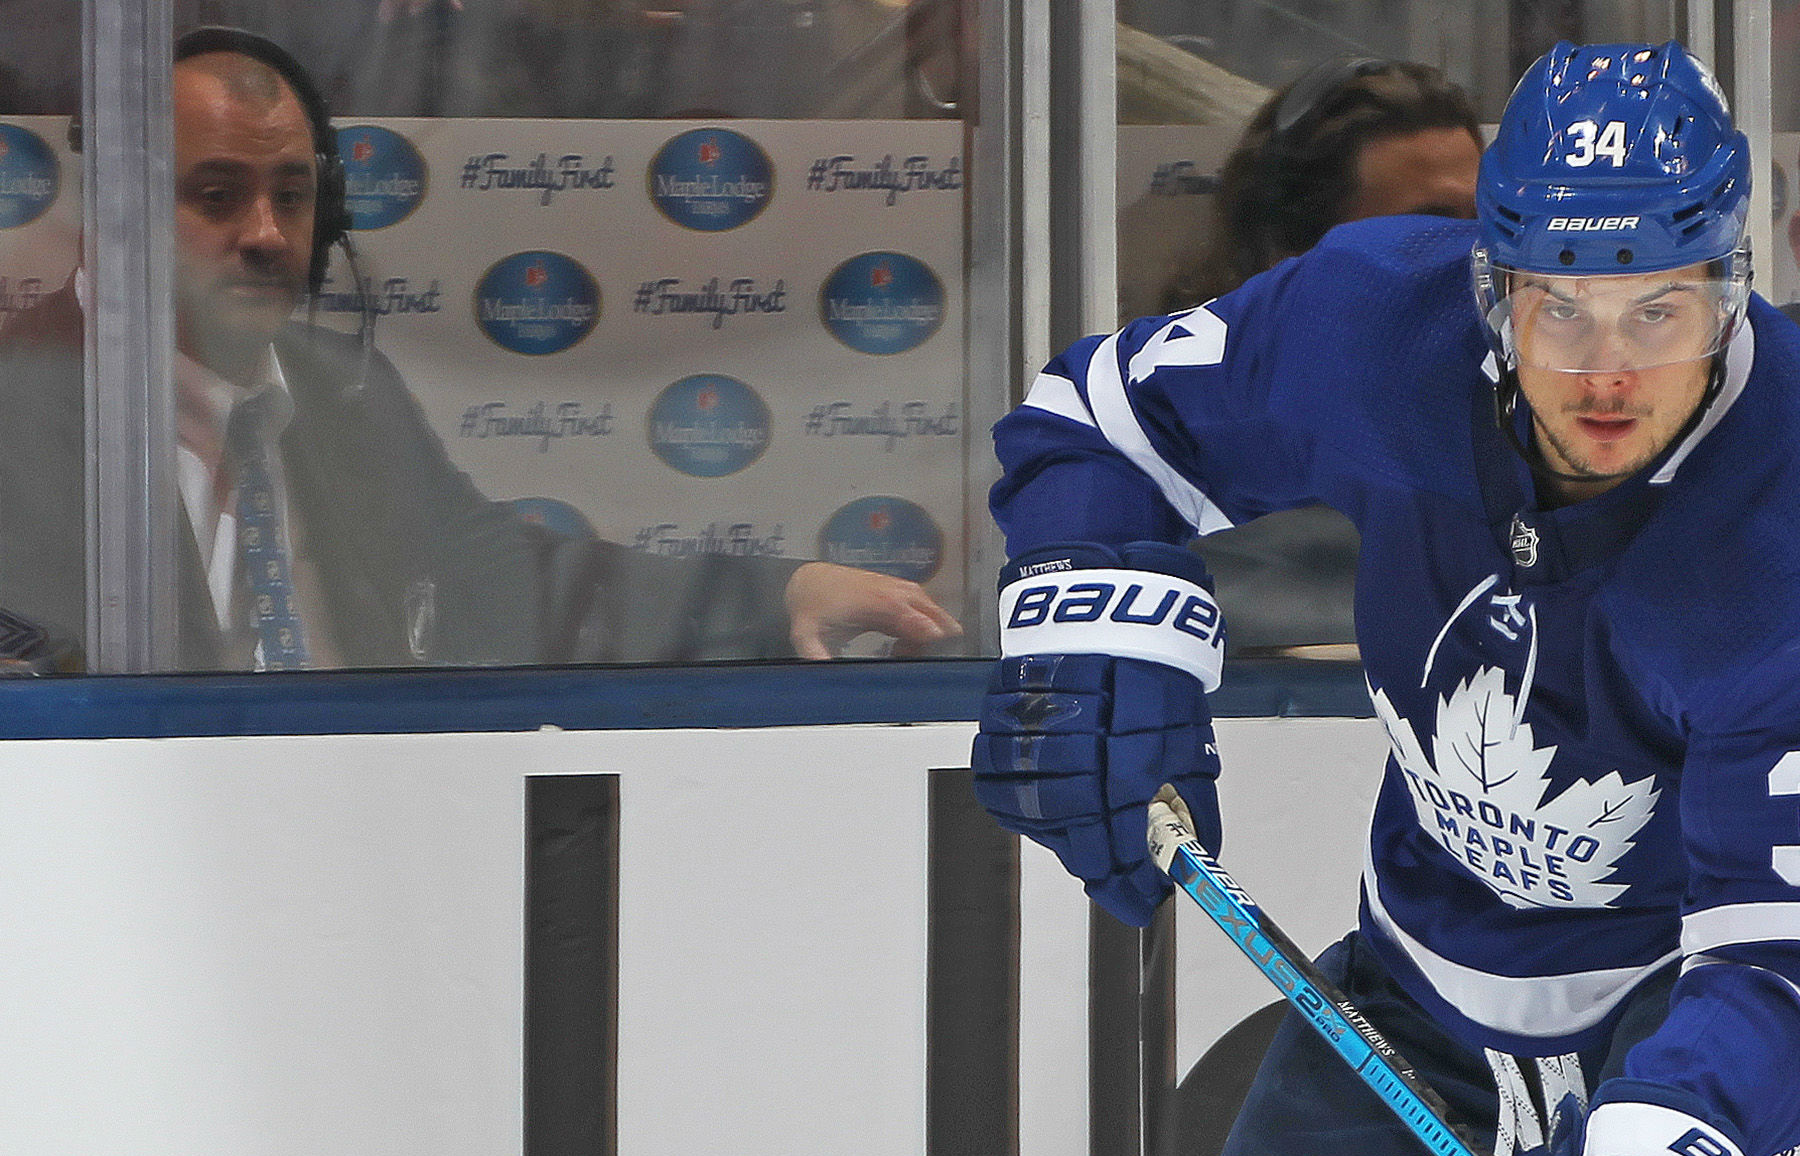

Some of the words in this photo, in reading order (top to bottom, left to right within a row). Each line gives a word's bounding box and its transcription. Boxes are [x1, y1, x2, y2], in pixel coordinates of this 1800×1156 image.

[1565, 121, 1627, 168] 34
[461, 152, 614, 206] #FamilyFirst
[807, 153, 963, 207] #FamilyFirst
[1547, 215, 1640, 232] BAUER
[634, 277, 785, 331] #FamilyFirst
[1019, 558, 1073, 578] MATTHEWS
[1404, 768, 1600, 865] TORONTO
[1433, 808, 1568, 878] MAPLE
[1442, 833, 1575, 902] LEAFS
[1337, 1000, 1396, 1057] MATTHEWS
